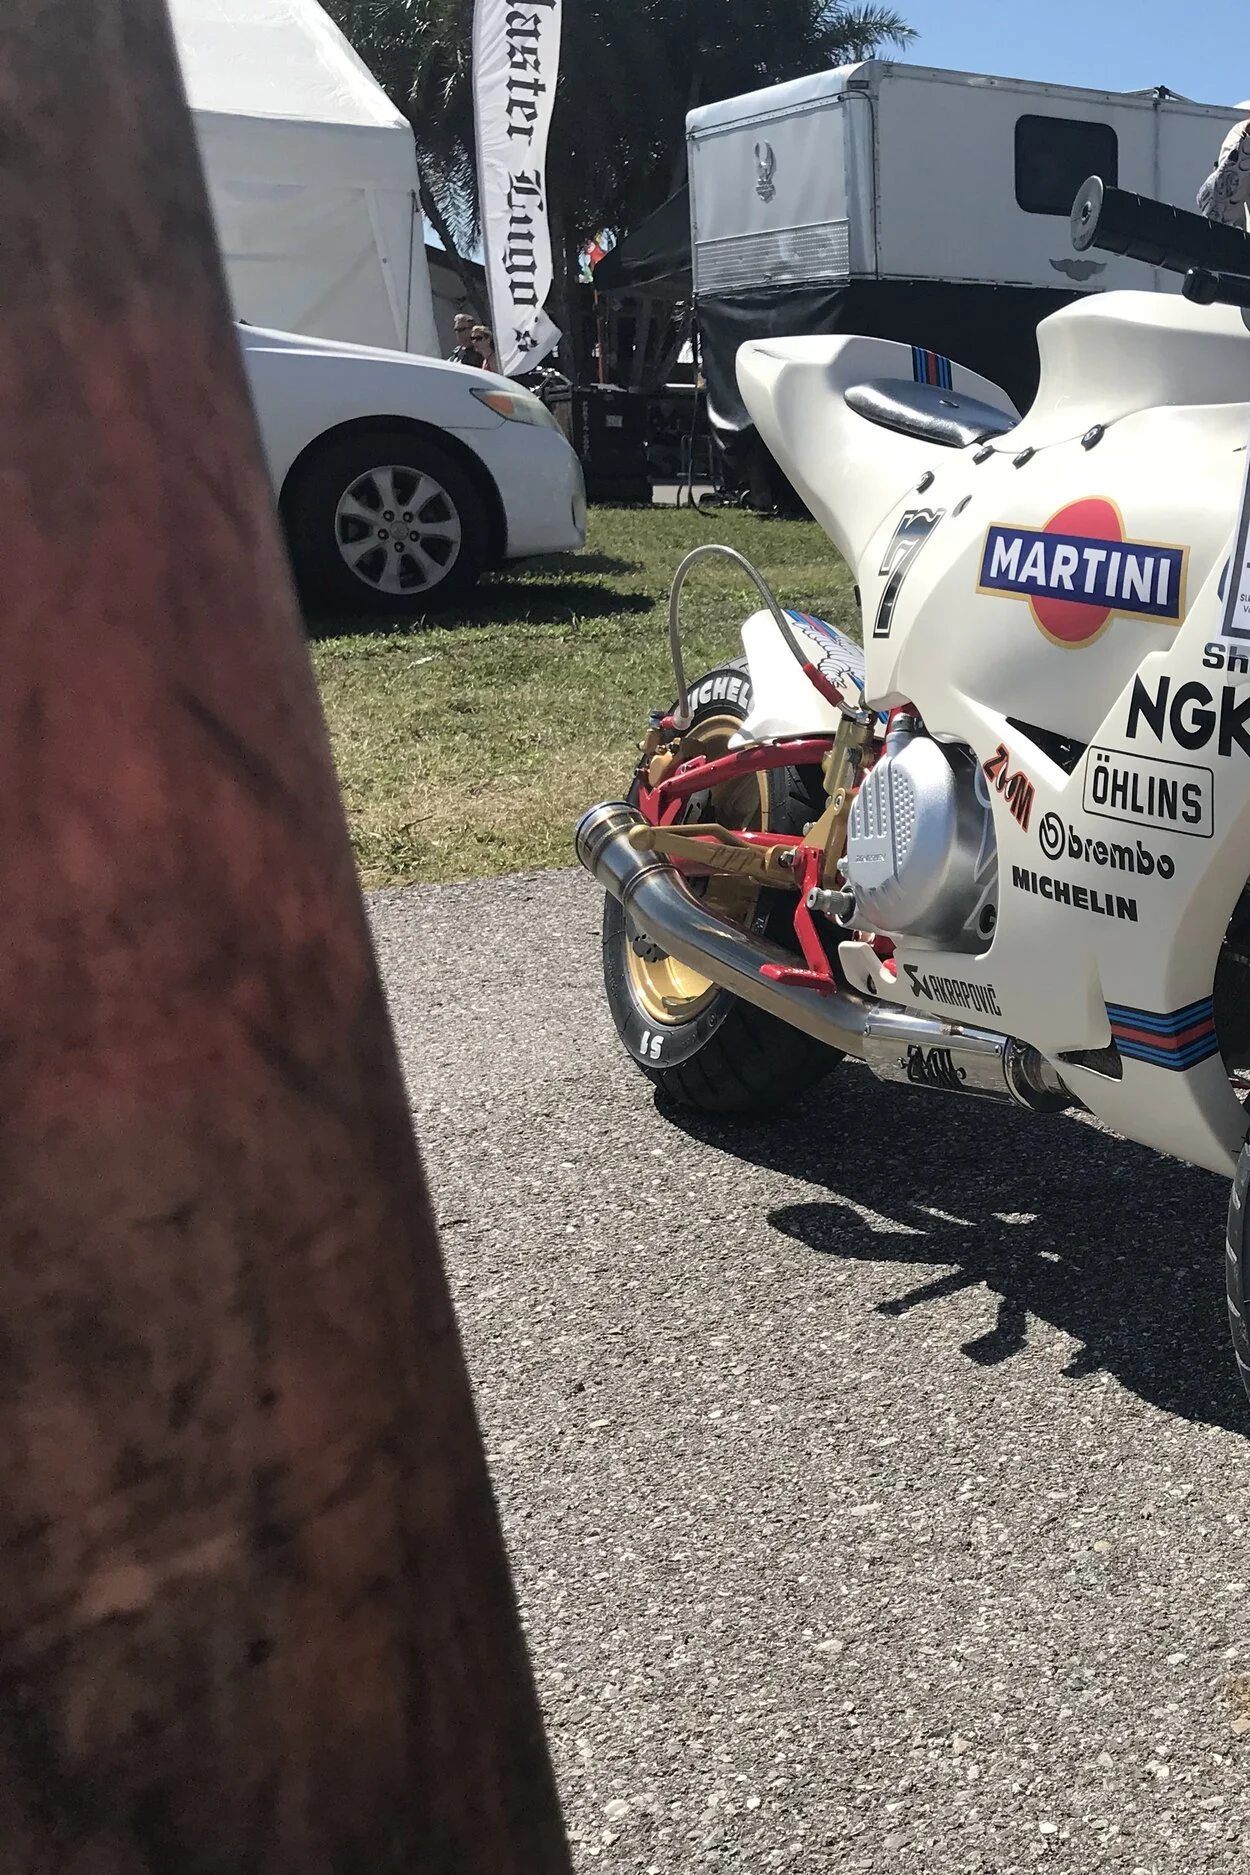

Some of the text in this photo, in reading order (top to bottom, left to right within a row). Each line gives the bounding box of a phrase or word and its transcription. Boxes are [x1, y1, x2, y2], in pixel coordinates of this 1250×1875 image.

[505, 0, 556, 147] aster
[873, 508, 947, 638] 7
[989, 535, 1171, 606] MARTINI
[687, 676, 754, 713] ICHEL
[1092, 753, 1202, 824] ÖHLINS
[1068, 824, 1175, 880] brembo
[1011, 865, 1139, 922] MICHELIN
[639, 1030, 665, 1060] S1
